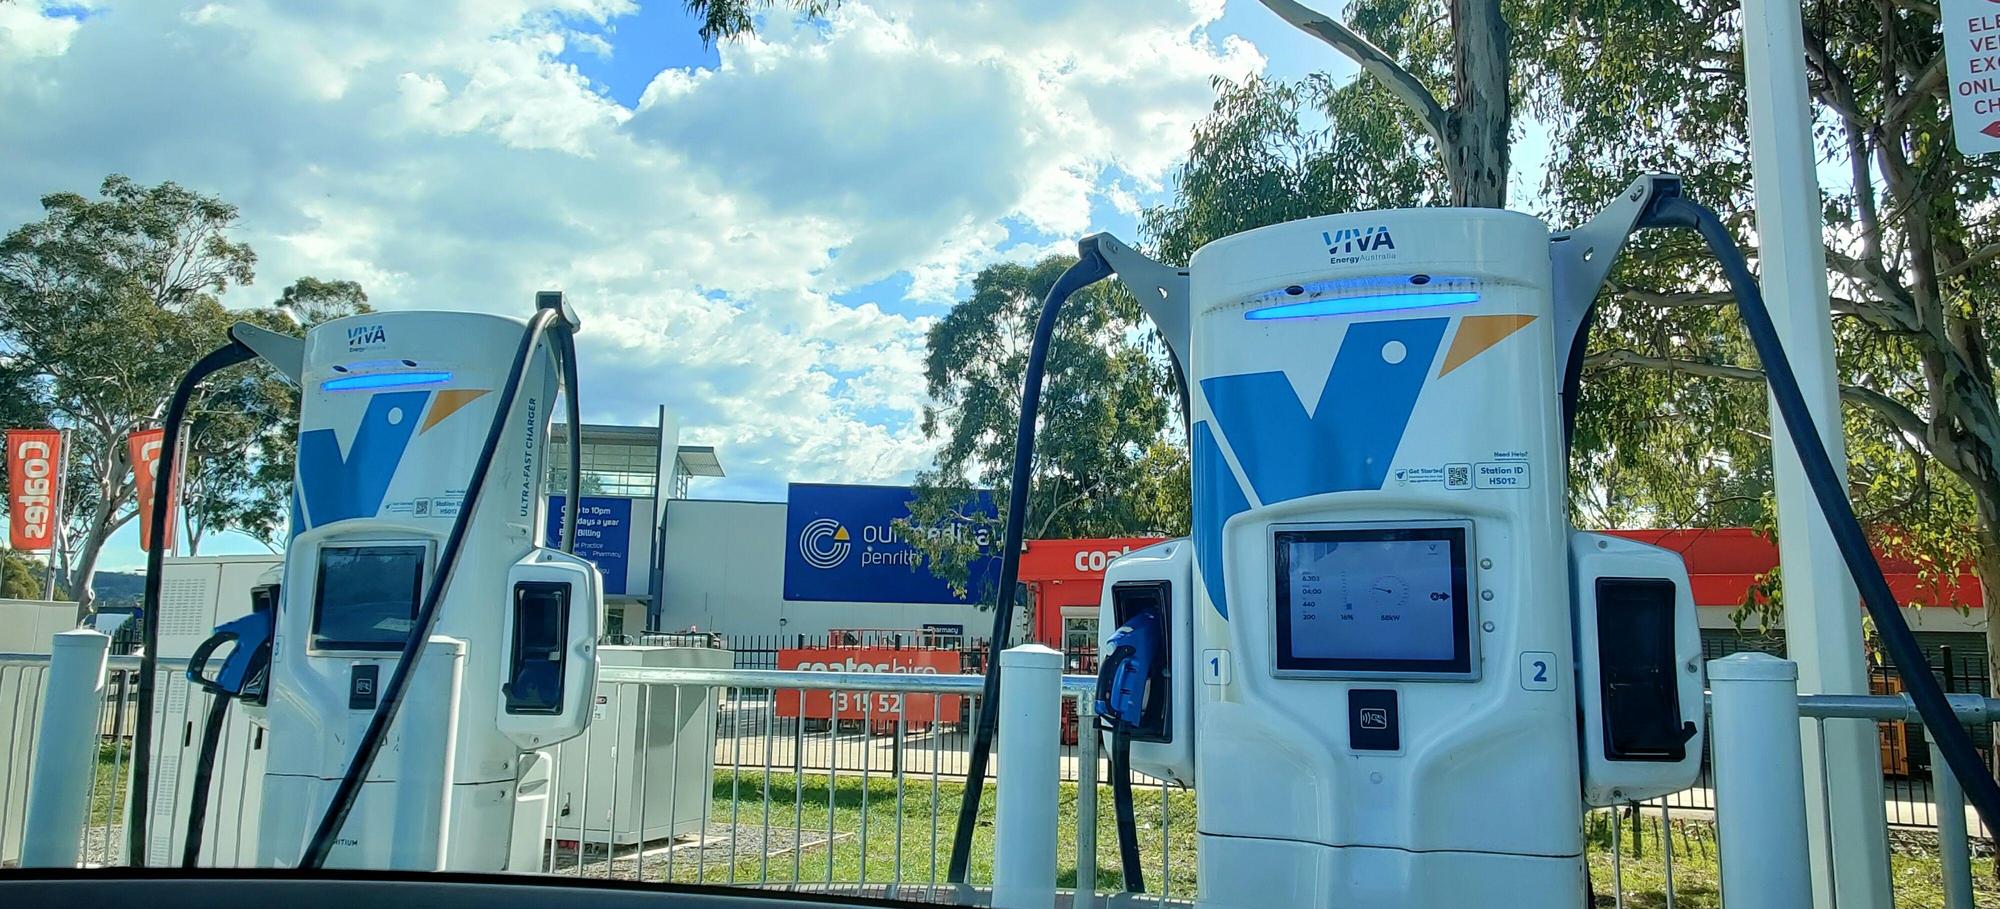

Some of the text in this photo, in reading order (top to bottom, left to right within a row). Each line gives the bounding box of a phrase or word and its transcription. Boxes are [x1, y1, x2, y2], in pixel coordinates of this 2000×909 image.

[1970, 35, 2000, 53] VE
[1970, 56, 2000, 74] EX
[1322, 226, 1395, 255] VIVA
[347, 325, 386, 345] VIVA
[520, 397, 537, 517] ULTRA-FAST CHARGER
[1480, 467, 1512, 475] Station
[1489, 477, 1517, 485] HS012
[582, 506, 590, 514] to
[591, 506, 611, 516] 10pm
[577, 518, 595, 526] days
[602, 519, 620, 527] year
[577, 529, 601, 538] Billing
[1210, 657, 1220, 677] 1
[1532, 661, 1548, 682] 2
[878, 694, 901, 713] 52
